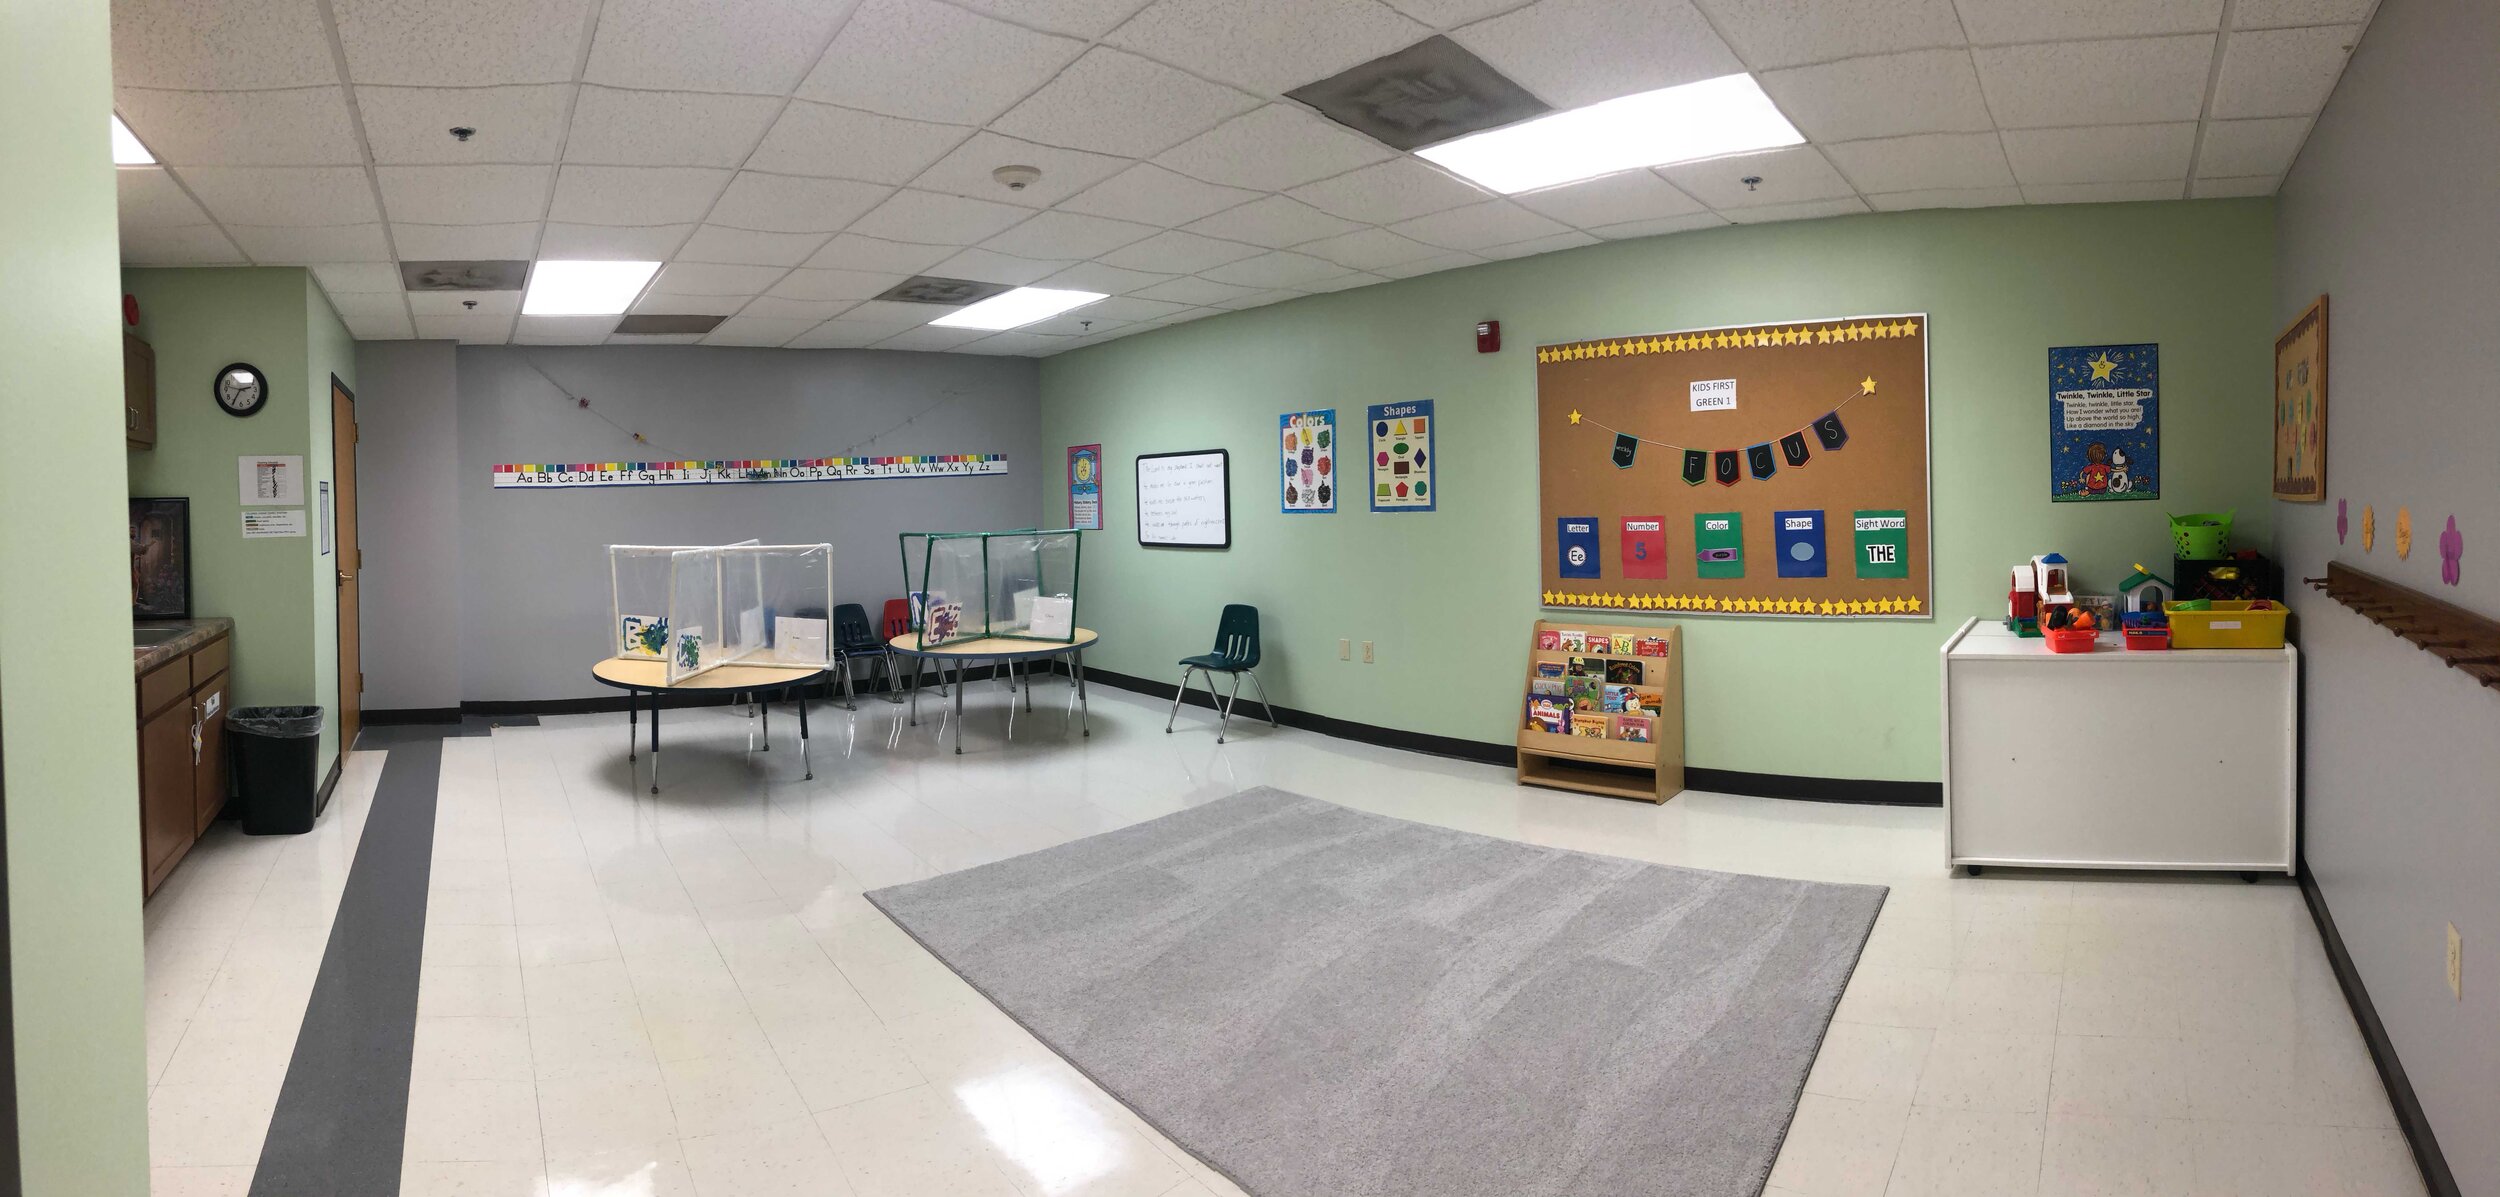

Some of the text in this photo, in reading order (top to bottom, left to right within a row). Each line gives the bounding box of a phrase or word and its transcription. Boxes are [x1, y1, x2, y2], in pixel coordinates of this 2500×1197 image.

[1692, 381, 1735, 393] KIDS FIRST
[1696, 397, 1731, 407] GREEN 1
[1383, 405, 1417, 417] Shapes
[1289, 413, 1325, 428] Colors
[517, 472, 532, 483] Aa
[537, 472, 553, 483] Bb
[558, 472, 573, 483] Cc
[579, 472, 594, 482] Dd
[600, 471, 614, 482] Ee
[620, 470, 633, 480] Ff
[638, 470, 655, 484] Gg
[659, 470, 674, 480] Hh
[683, 469, 690, 480] Ii
[700, 469, 712, 484] Jj
[718, 469, 731, 479] Kk
[774, 468, 787, 477] Nn
[790, 467, 804, 477] Oo
[810, 467, 822, 480] Pp
[827, 466, 842, 478] Qq
[846, 465, 858, 475] Rr
[864, 465, 875, 475] Ss
[881, 464, 892, 474] Tt
[898, 463, 910, 473] Uu
[915, 463, 926, 473] Vv
[929, 462, 944, 472] Ww
[946, 462, 959, 472] Xx
[963, 462, 974, 475] Yy
[979, 461, 990, 471] Zz
[1567, 524, 1589, 532] Letter
[1627, 523, 1658, 531] Number
[1706, 521, 1728, 530] Color
[1785, 519, 1812, 529] Shape
[1856, 518, 1905, 530] Sight Word
[1571, 550, 1584, 562] Ee
[1635, 542, 1647, 560] 5
[1868, 546, 1895, 562] THE
[1533, 710, 1560, 718] ANIMALS
